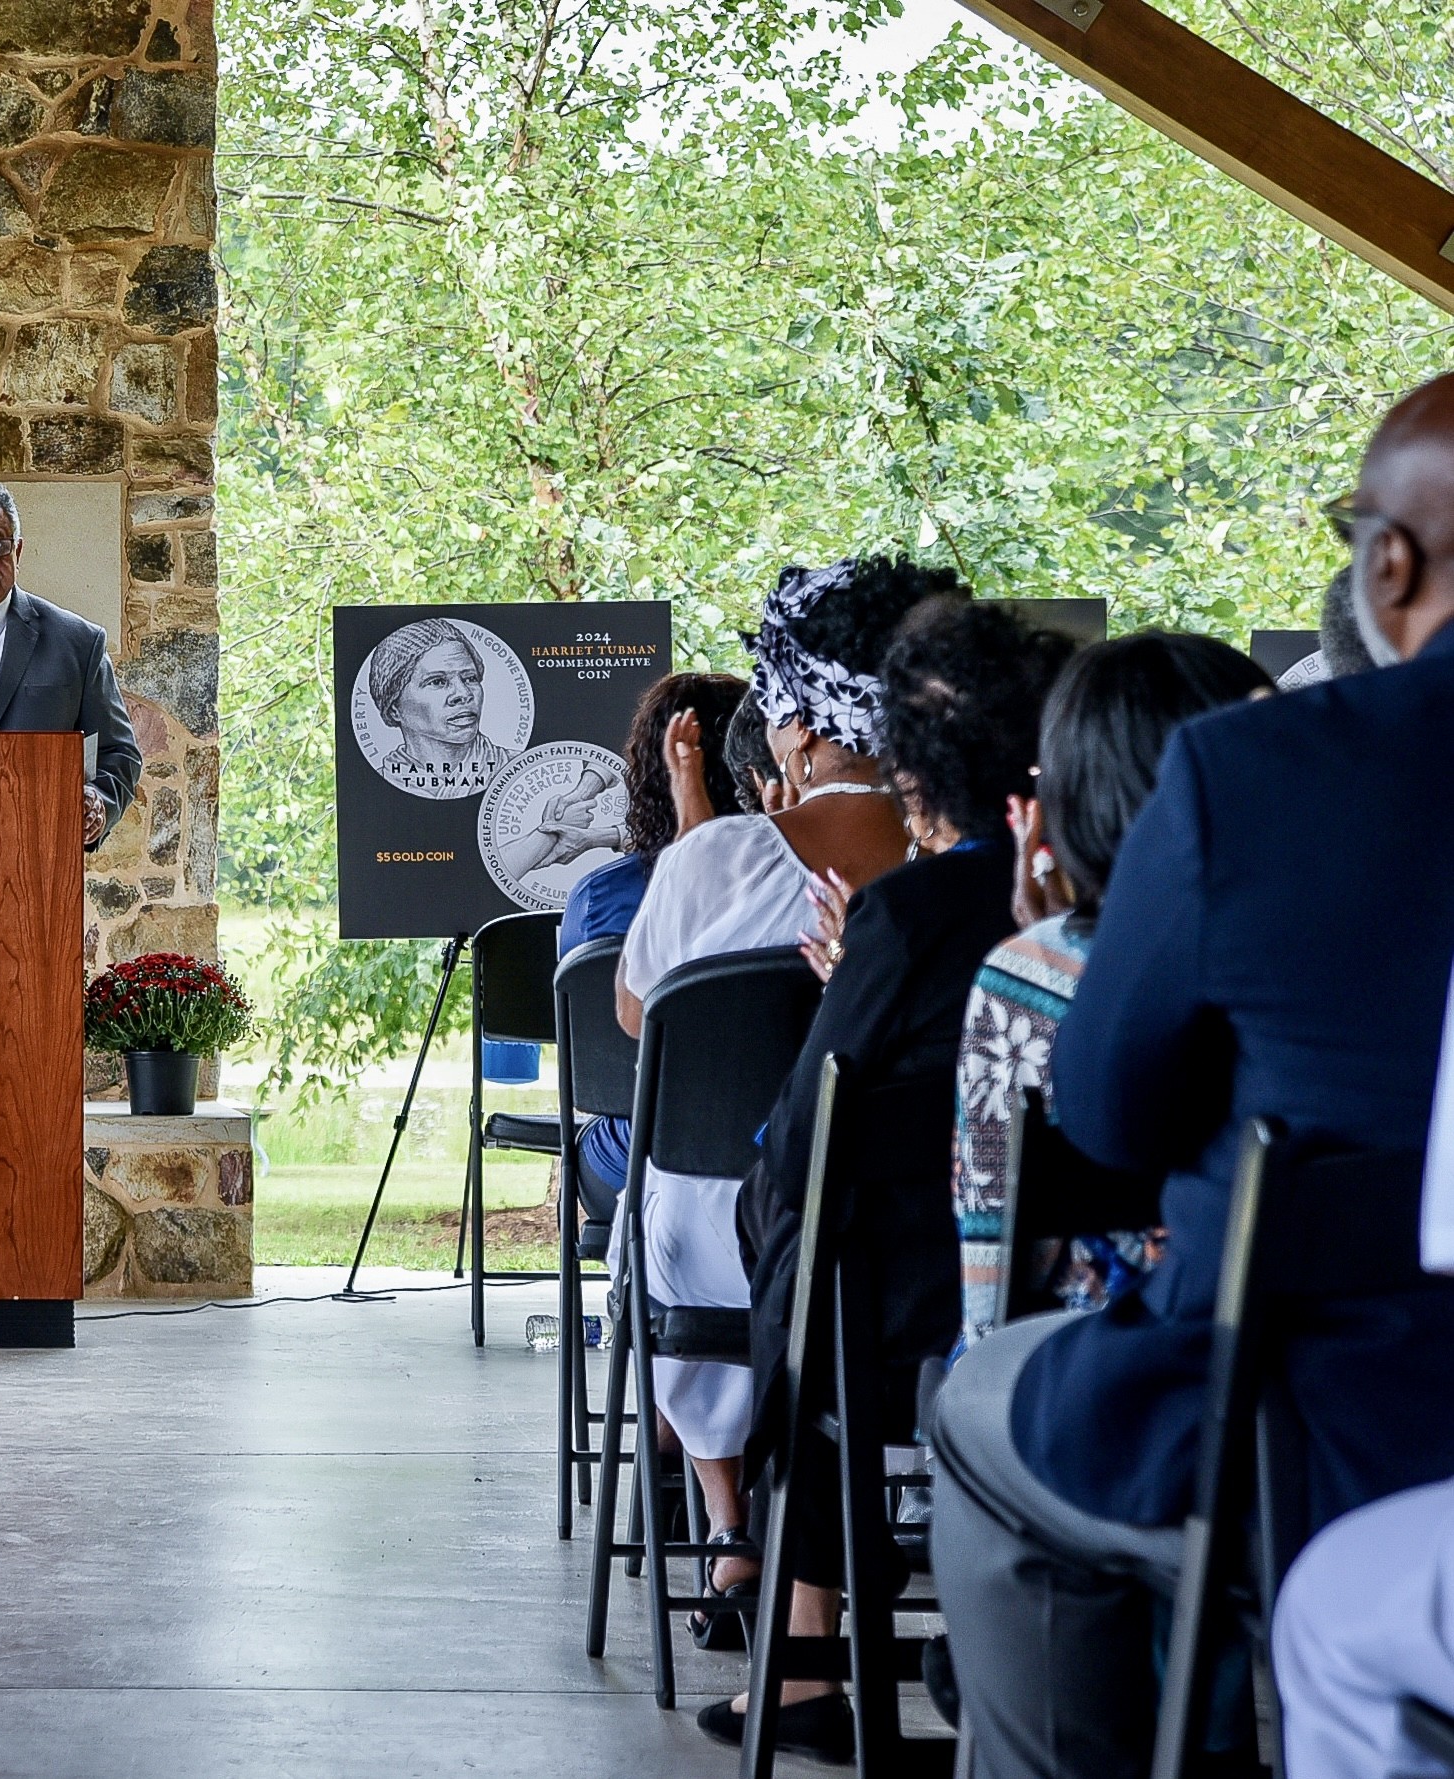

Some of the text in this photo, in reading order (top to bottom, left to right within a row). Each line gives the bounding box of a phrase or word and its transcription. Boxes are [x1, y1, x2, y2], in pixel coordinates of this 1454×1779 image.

[575, 632, 612, 645] 2024
[531, 644, 657, 657] HARRIET TUBMAN
[537, 657, 652, 668] COMMEMORATIVE
[577, 669, 612, 680] COIN
[470, 628, 531, 746] IN GOD WE TRUST 2024
[354, 687, 379, 758] LIBERTY
[391, 761, 496, 773] HARRIET
[402, 776, 485, 788] TUBMAN
[482, 751, 544, 848] SELF-DETERMINATION
[550, 746, 583, 756] FAITH
[498, 761, 572, 836] UNITED STATES
[510, 774, 573, 836] OF AMERICA
[600, 793, 628, 818] $5
[376, 851, 454, 863] $5 GOLD COIN
[487, 852, 516, 891] SOCIAL
[531, 881, 541, 892] E
